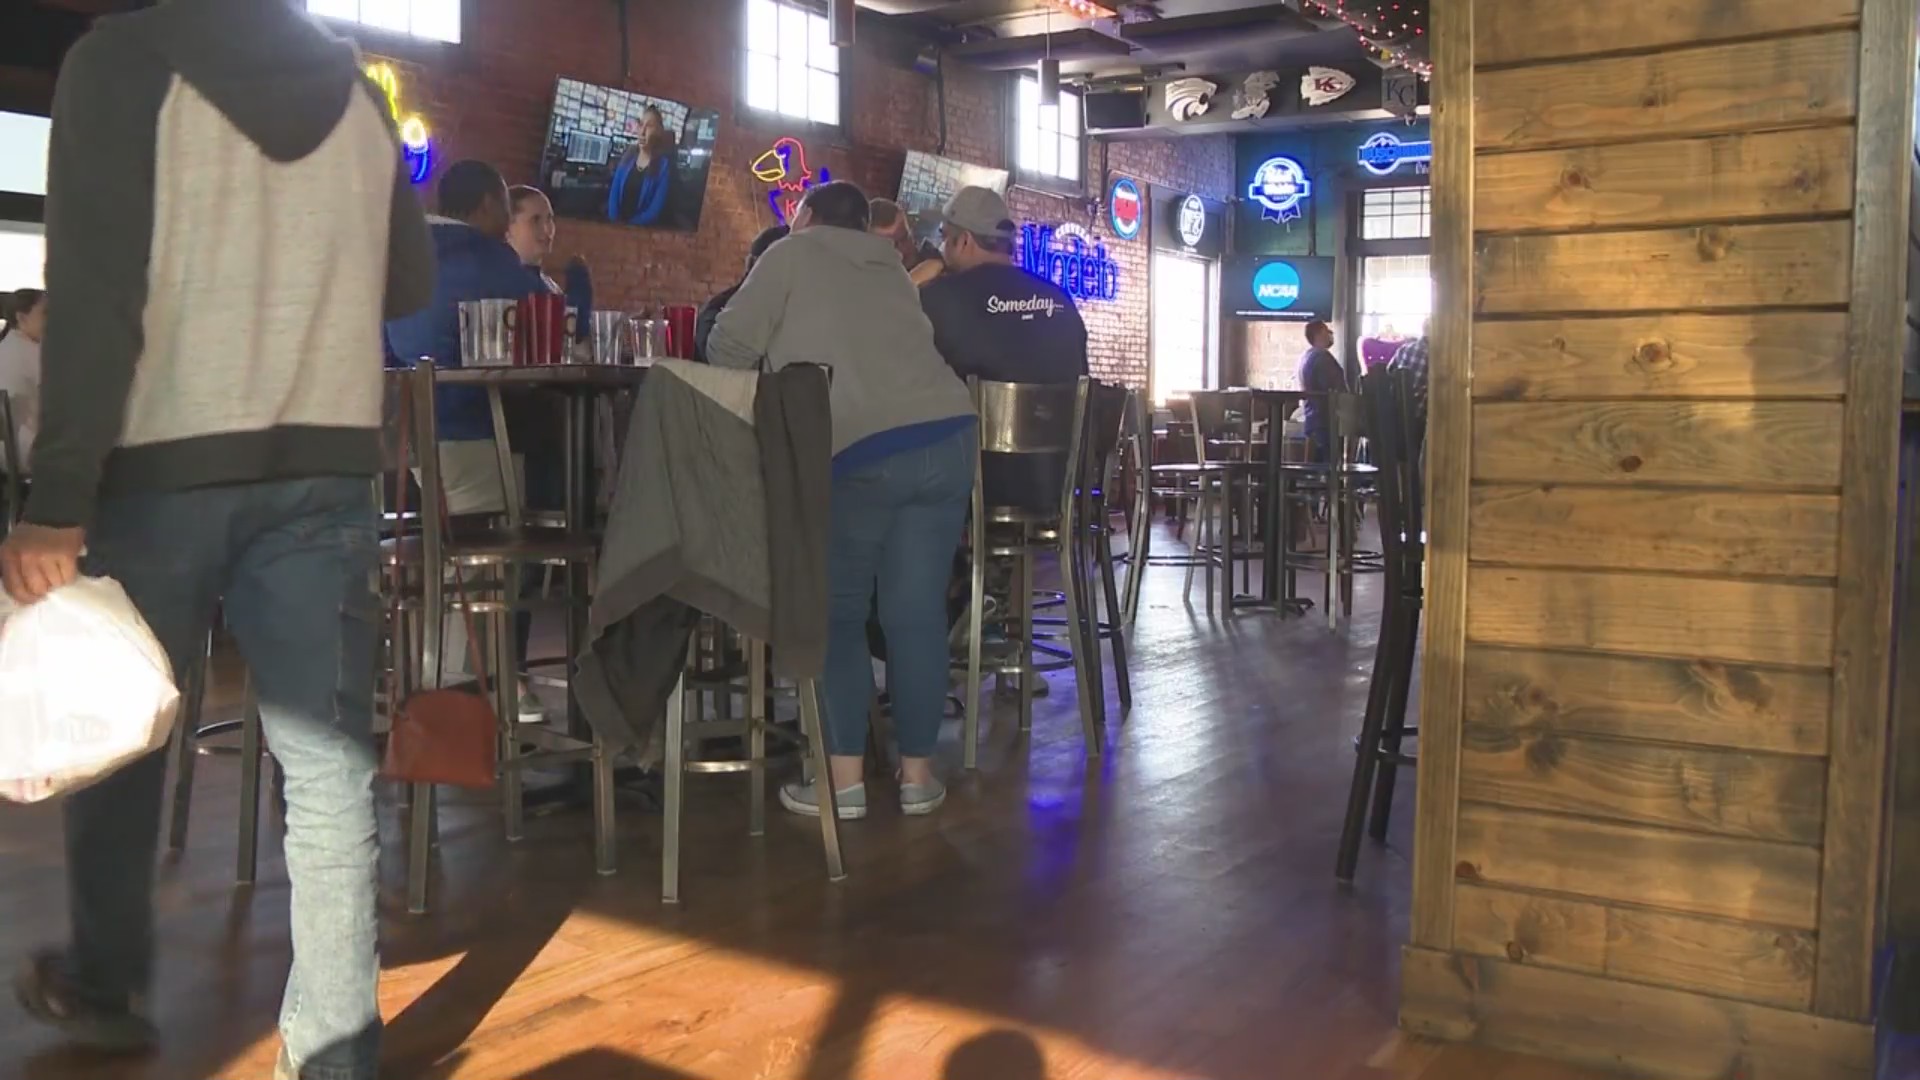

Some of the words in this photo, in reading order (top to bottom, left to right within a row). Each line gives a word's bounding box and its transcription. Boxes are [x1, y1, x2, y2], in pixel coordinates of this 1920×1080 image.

[1386, 79, 1415, 108] KC
[1022, 225, 1117, 302] Modelo
[1258, 283, 1299, 299] NCAA
